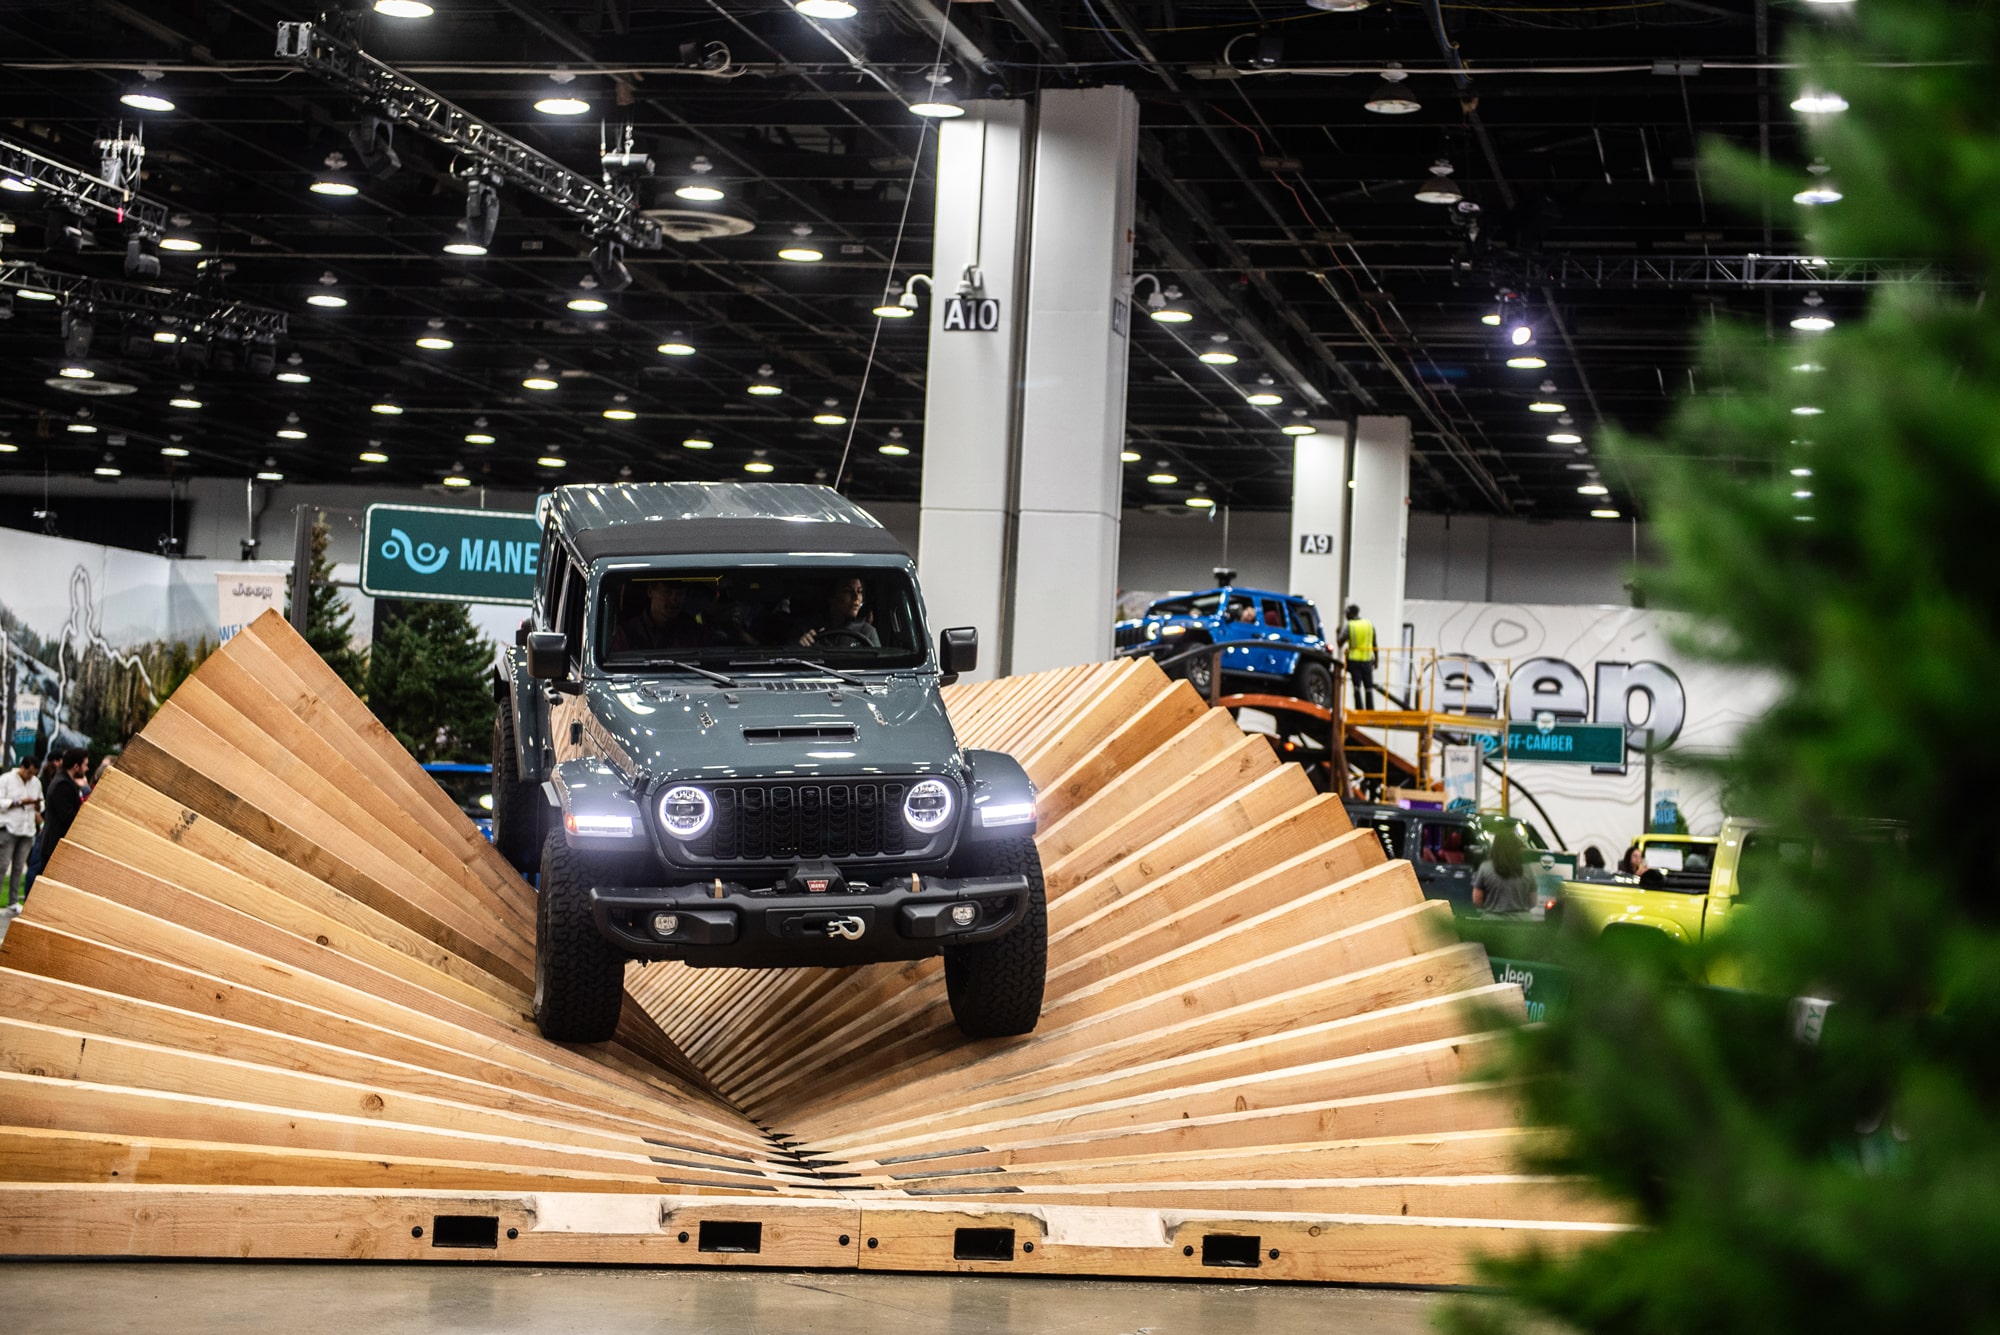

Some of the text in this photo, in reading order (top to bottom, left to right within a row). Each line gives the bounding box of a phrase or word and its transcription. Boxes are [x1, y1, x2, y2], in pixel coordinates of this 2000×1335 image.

[944, 299, 998, 330] A10
[460, 537, 545, 576] MANE
[1303, 534, 1329, 554] A9
[232, 582, 273, 600] Jeep
[1499, 963, 1534, 993] Jeep
